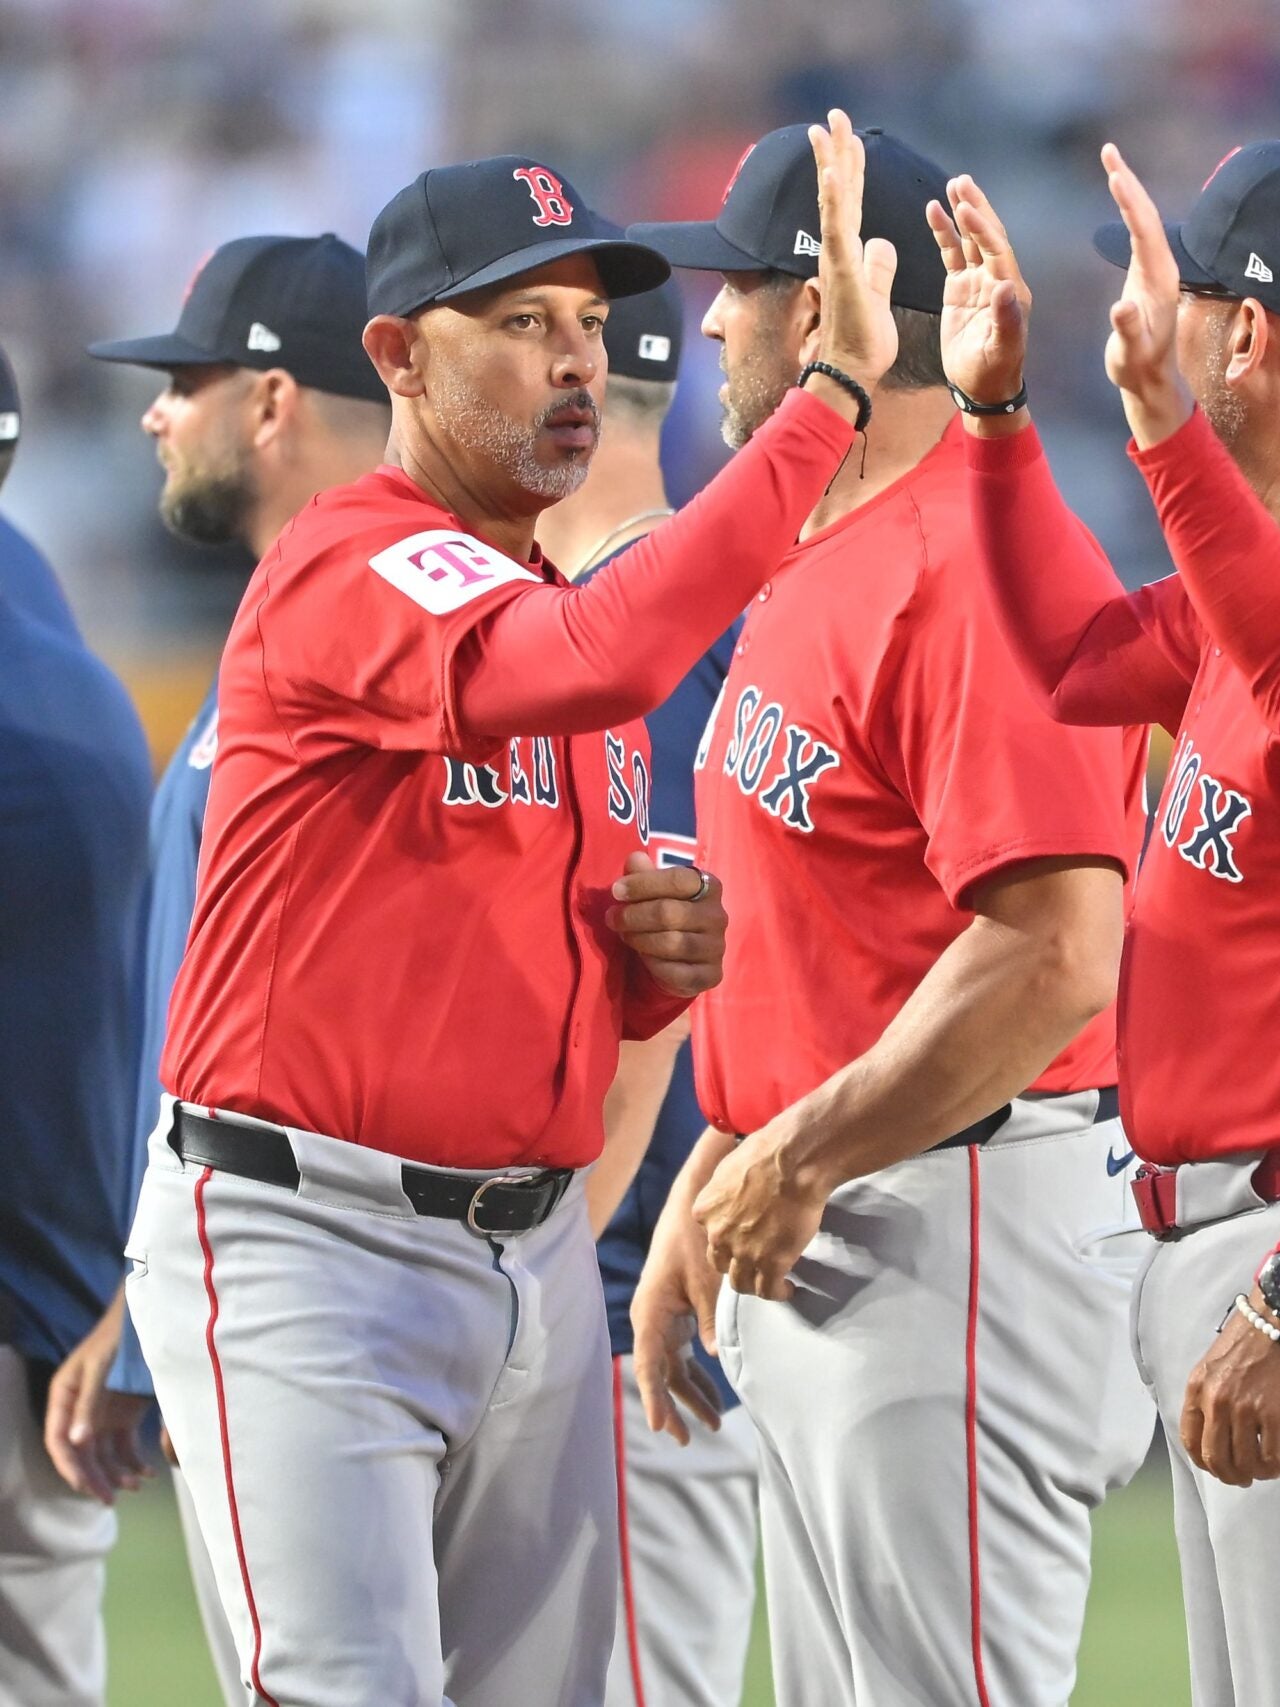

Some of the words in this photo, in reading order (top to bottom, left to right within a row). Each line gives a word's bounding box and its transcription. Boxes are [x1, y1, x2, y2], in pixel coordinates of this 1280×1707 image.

[513, 166, 574, 227] B
[407, 541, 495, 588] T
[723, 684, 840, 833] SOX
[1161, 739, 1252, 884] OX
